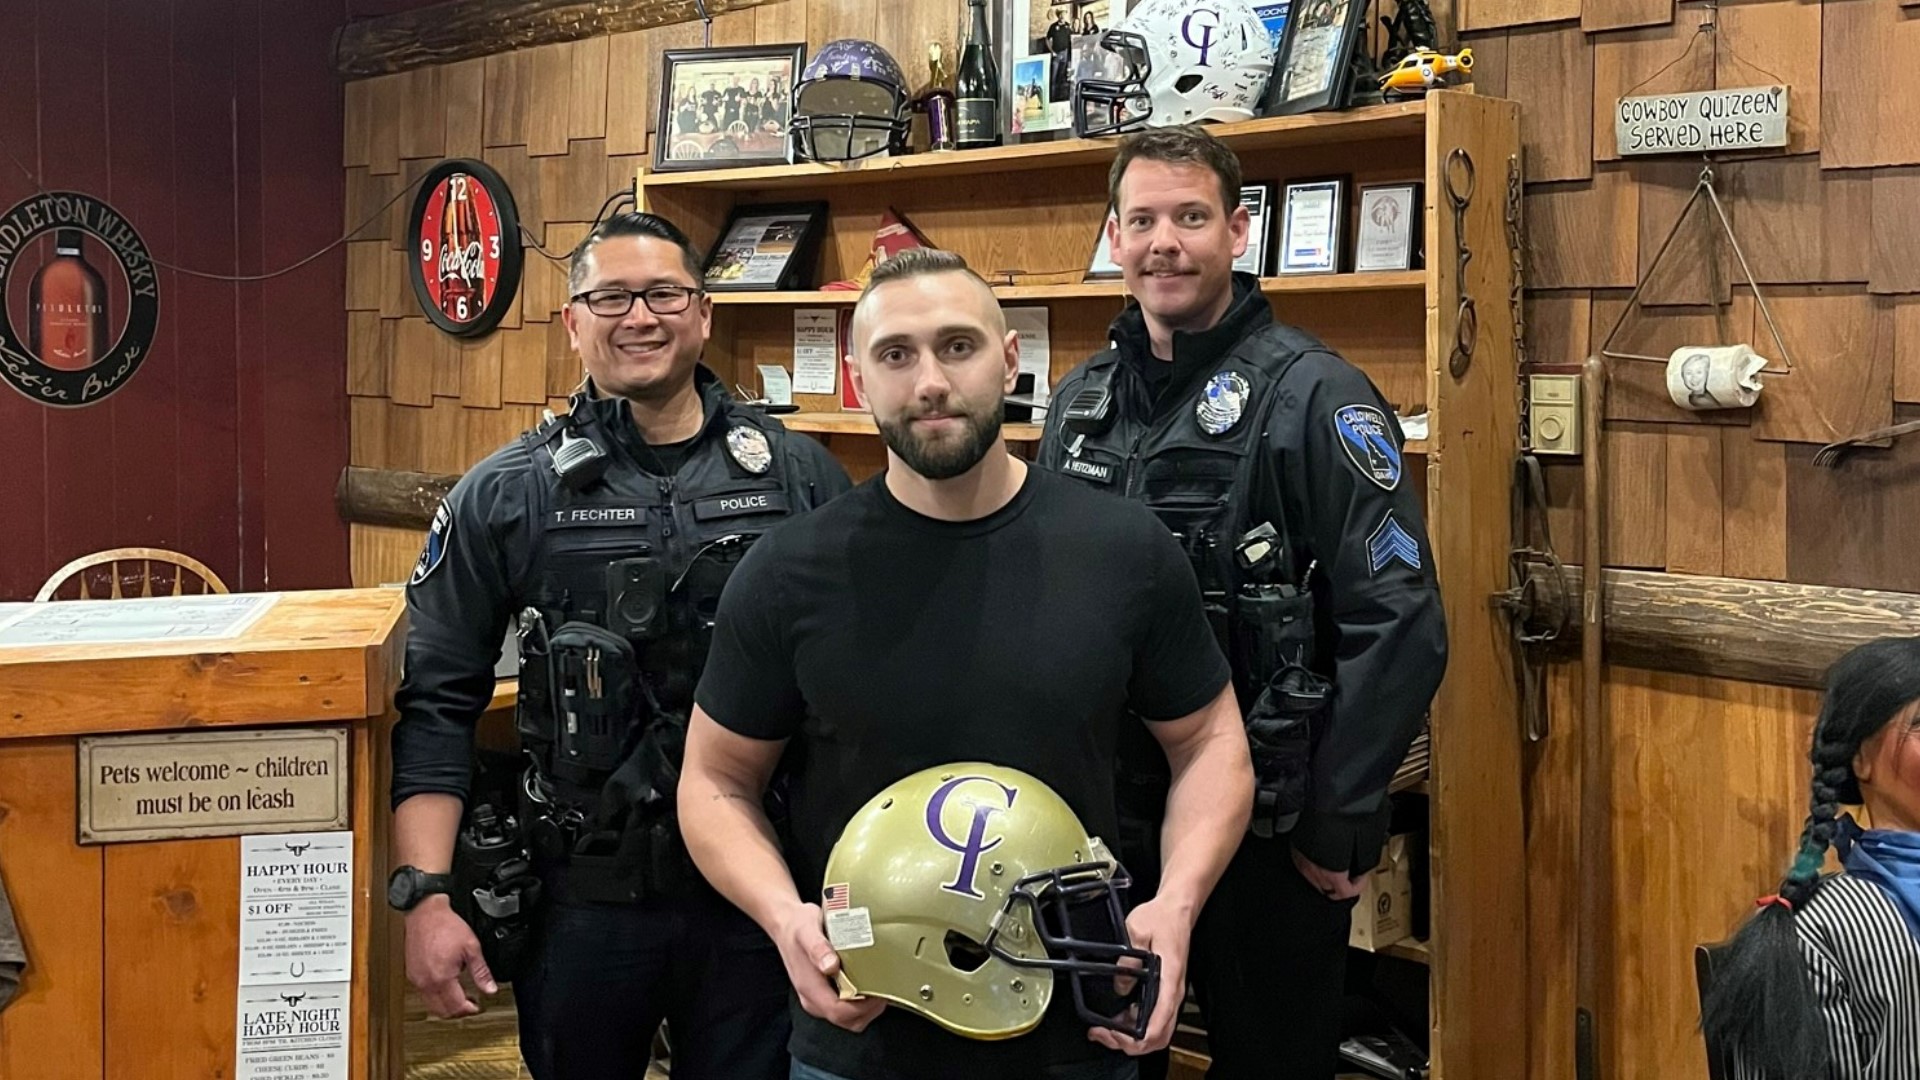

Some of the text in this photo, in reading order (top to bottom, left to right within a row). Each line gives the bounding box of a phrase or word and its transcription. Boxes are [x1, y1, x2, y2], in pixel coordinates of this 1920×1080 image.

[1621, 99, 1688, 123] COWBOY
[450, 177, 468, 200] 12
[97, 208, 156, 297] WHISKY
[422, 238, 433, 261] 9
[489, 236, 500, 259] 3
[456, 296, 468, 319] 6
[82, 345, 140, 400] Buck
[1352, 424, 1384, 435] POLICE
[720, 495, 768, 510] POLICE
[555, 508, 635, 522] T. FECHTER
[100, 765, 140, 785] Pets
[146, 761, 230, 782] welcome
[255, 756, 329, 779] children
[136, 788, 295, 815] must be on leash
[247, 862, 348, 876] HAPPY HOUR
[247, 905, 261, 916] $1
[265, 903, 293, 914] OFF
[244, 1008, 341, 1024] LATE NIGHT
[244, 1021, 340, 1036] HAPPY HOUR
